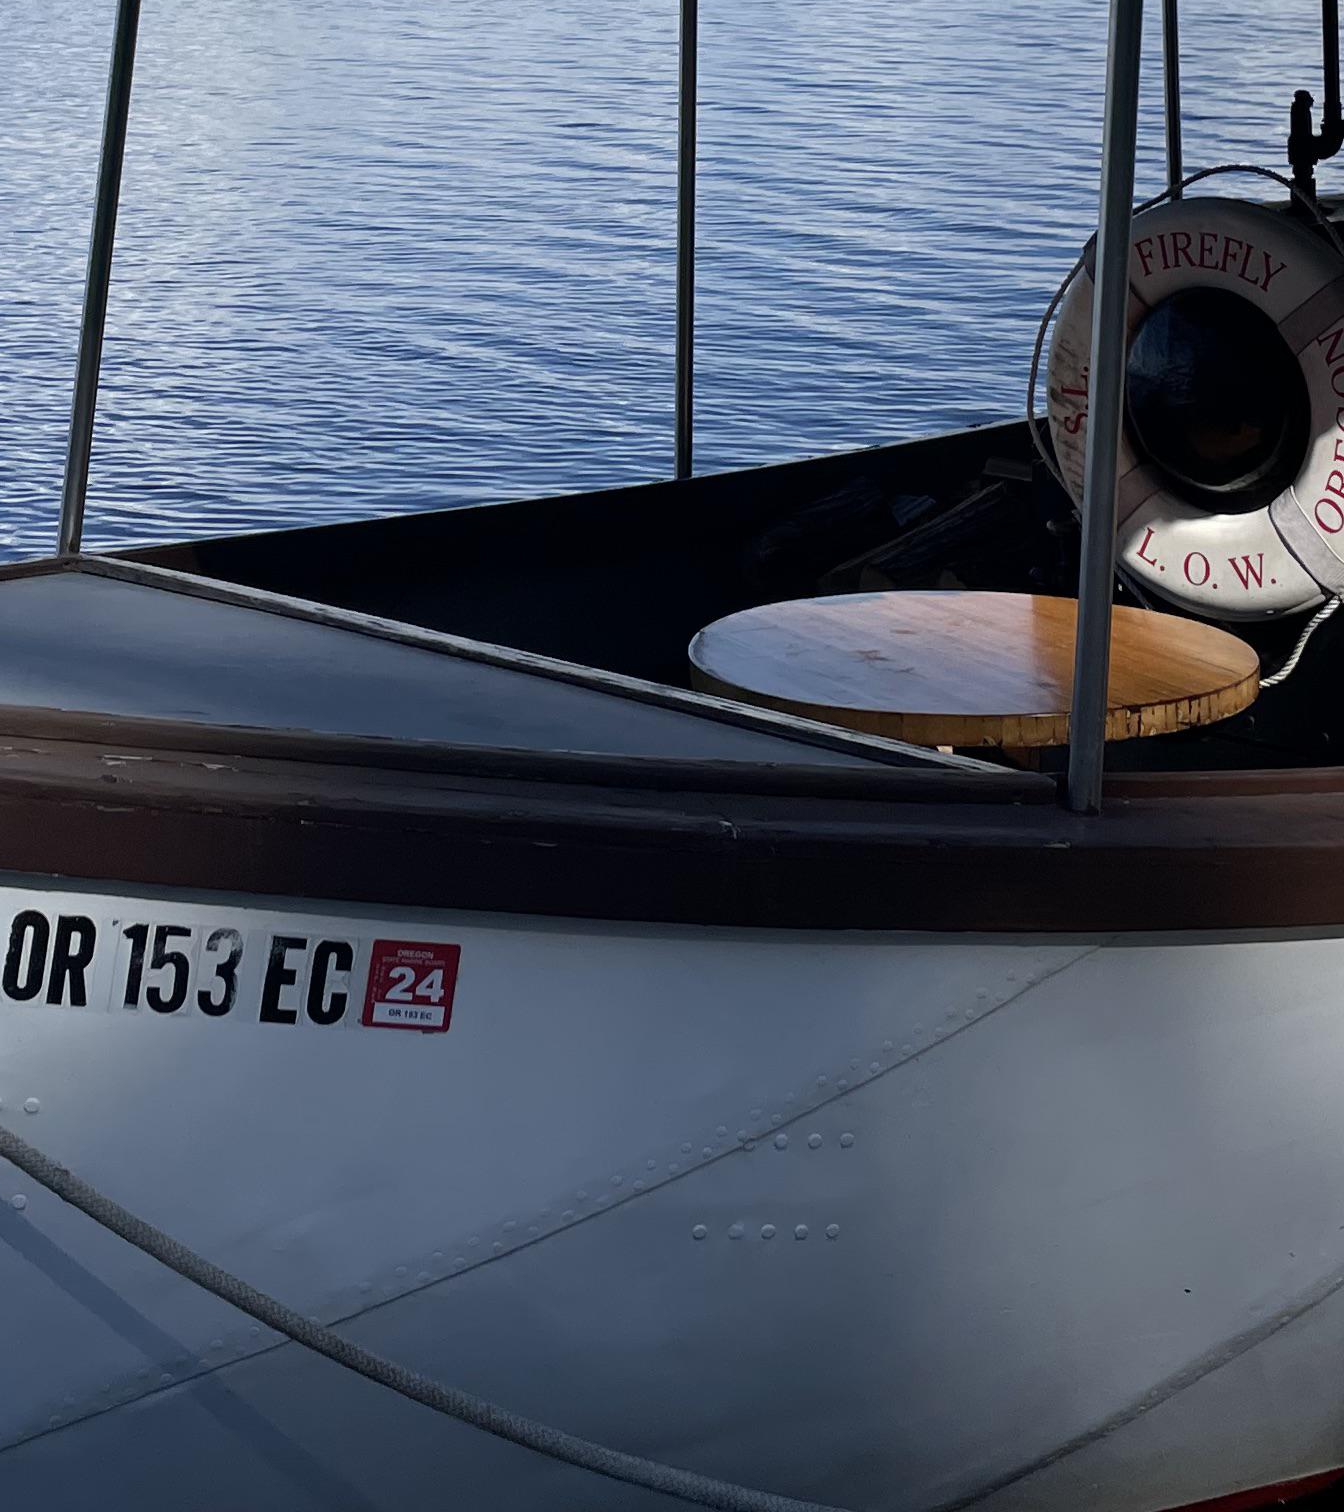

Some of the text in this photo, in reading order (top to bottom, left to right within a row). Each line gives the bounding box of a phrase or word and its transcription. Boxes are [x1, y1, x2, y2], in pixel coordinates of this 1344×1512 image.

[1134, 231, 1287, 293] FIREFLY
[1, 909, 97, 1008] OR
[122, 921, 246, 1017] 153
[258, 935, 355, 1026] EC
[397, 949, 434, 960] OREGON
[385, 966, 445, 1003] 24
[388, 1008, 402, 1018] OR
